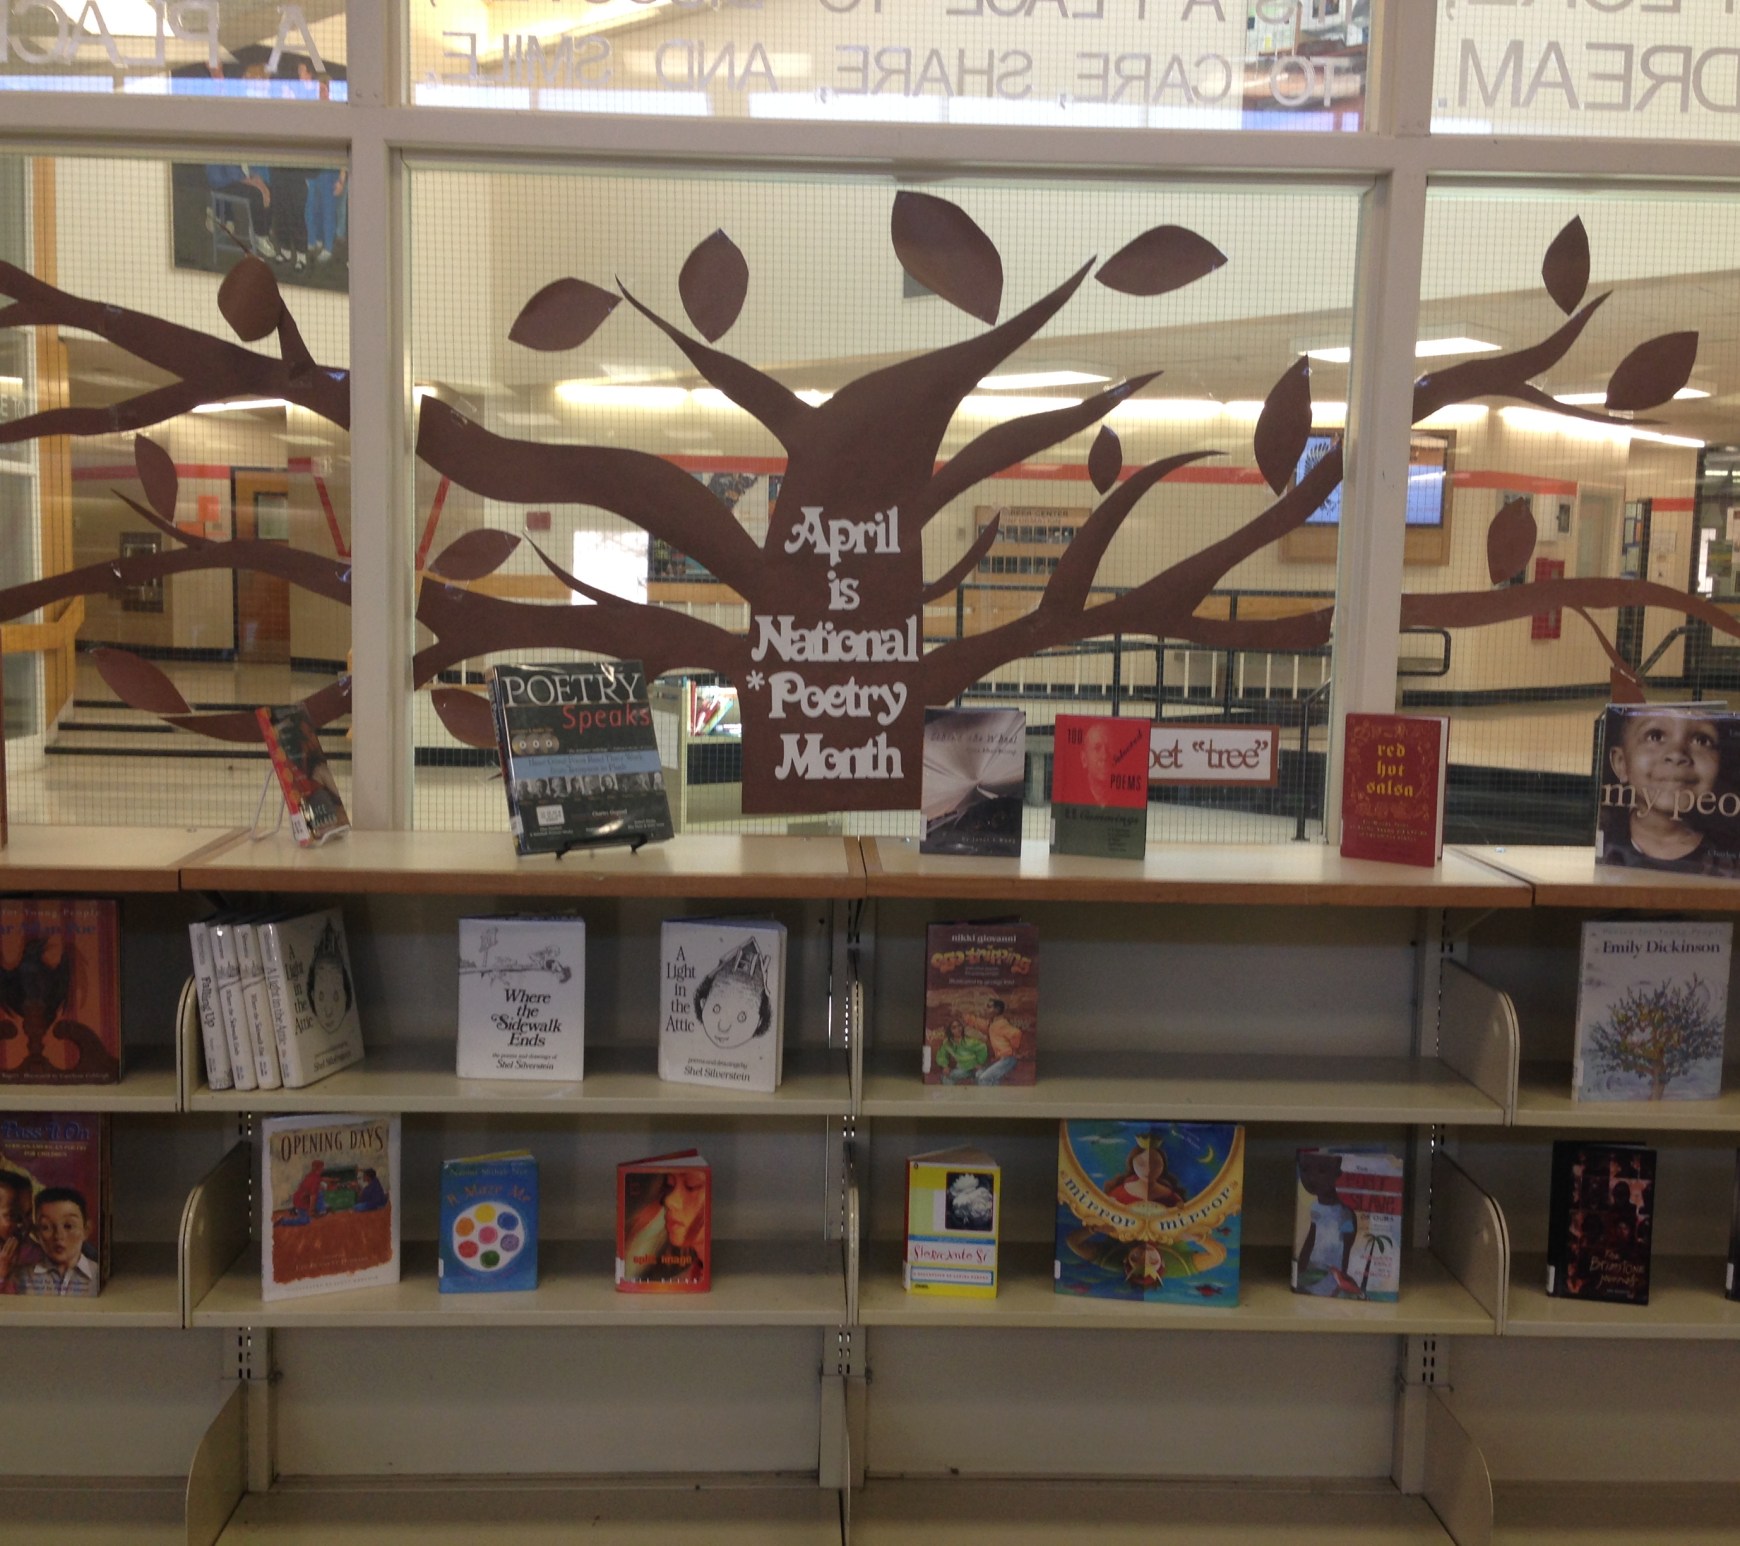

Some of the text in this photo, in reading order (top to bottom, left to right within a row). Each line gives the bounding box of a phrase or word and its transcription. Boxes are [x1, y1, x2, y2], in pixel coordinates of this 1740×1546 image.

[785, 506, 901, 566] April
[828, 570, 860, 611] is
[751, 614, 919, 662] National
[502, 672, 641, 707] POETRY
[562, 703, 650, 735] Speaks
[1068, 727, 1083, 745] 100
[775, 731, 904, 780] Month
[1377, 741, 1406, 758] red
[1377, 759, 1406, 778] hot
[1110, 773, 1142, 792] POEMS
[1366, 779, 1414, 798] salsa
[1601, 783, 1660, 818] my
[951, 934, 1017, 944] nikki giovanni
[1603, 939, 1720, 959] Emily Dickinson
[676, 946, 686, 961] A
[667, 962, 696, 982] Light
[201, 976, 213, 1012] Falling
[504, 987, 551, 1004] Where
[674, 983, 686, 998] in
[516, 1004, 539, 1020] the
[671, 998, 691, 1015] the
[204, 1007, 216, 1029] Up
[295, 1016, 314, 1036] Attic
[491, 1013, 562, 1035] Sidewalk
[665, 1015, 695, 1034] Attic
[507, 1033, 546, 1048] Ends
[496, 1059, 514, 1070] Shel
[684, 1065, 751, 1083] Shel Silverstein
[1, 1119, 42, 1139] Pass
[64, 1120, 90, 1140] On
[281, 1126, 384, 1162] OPENING DAYS
[1064, 1178, 1231, 1231] mirror mirror
